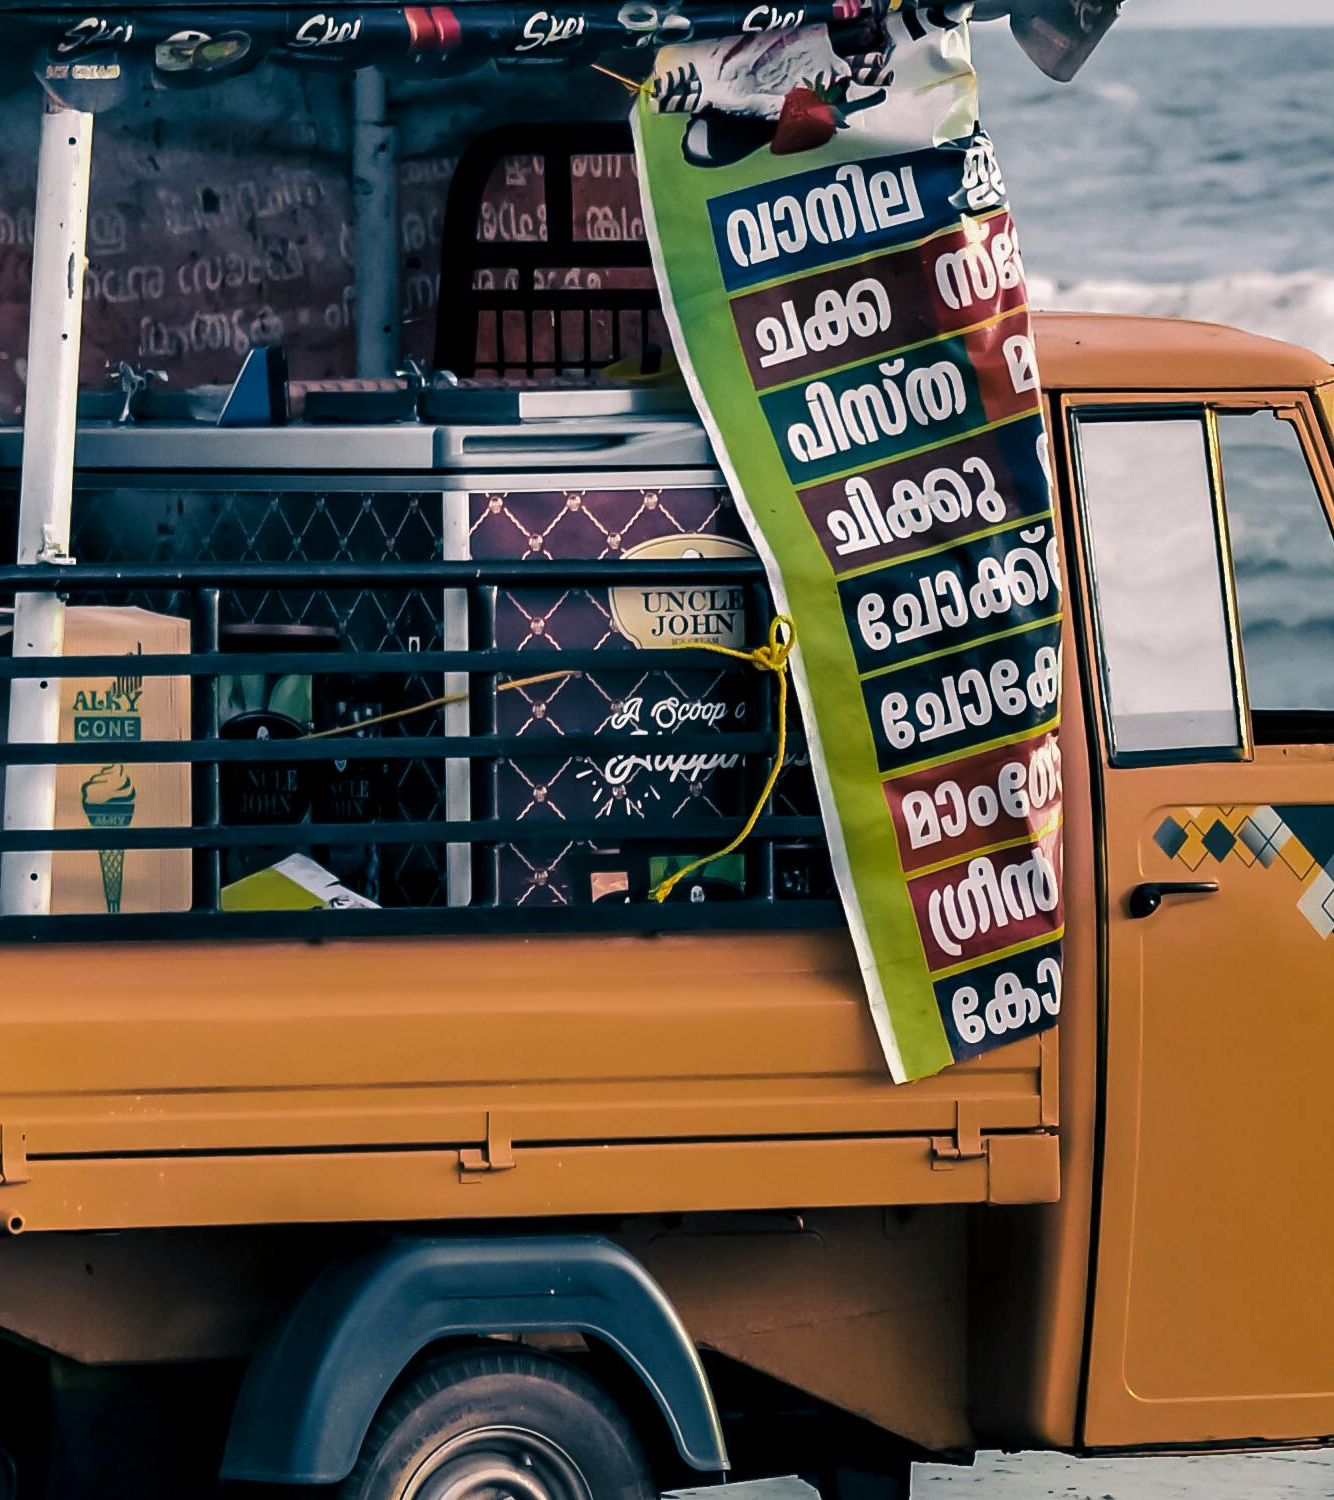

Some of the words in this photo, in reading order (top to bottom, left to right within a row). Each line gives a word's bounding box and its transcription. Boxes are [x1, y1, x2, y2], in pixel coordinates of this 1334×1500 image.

[726, 164, 924, 268] വാനില
[755, 277, 892, 368] ചക്ക
[787, 358, 967, 462] പിസ്ത
[826, 457, 1008, 556] ചിക്കു
[641, 590, 744, 612] UNCLE
[651, 613, 736, 636] JOHN
[72, 691, 143, 711] ALKY
[78, 720, 135, 738] CONE
